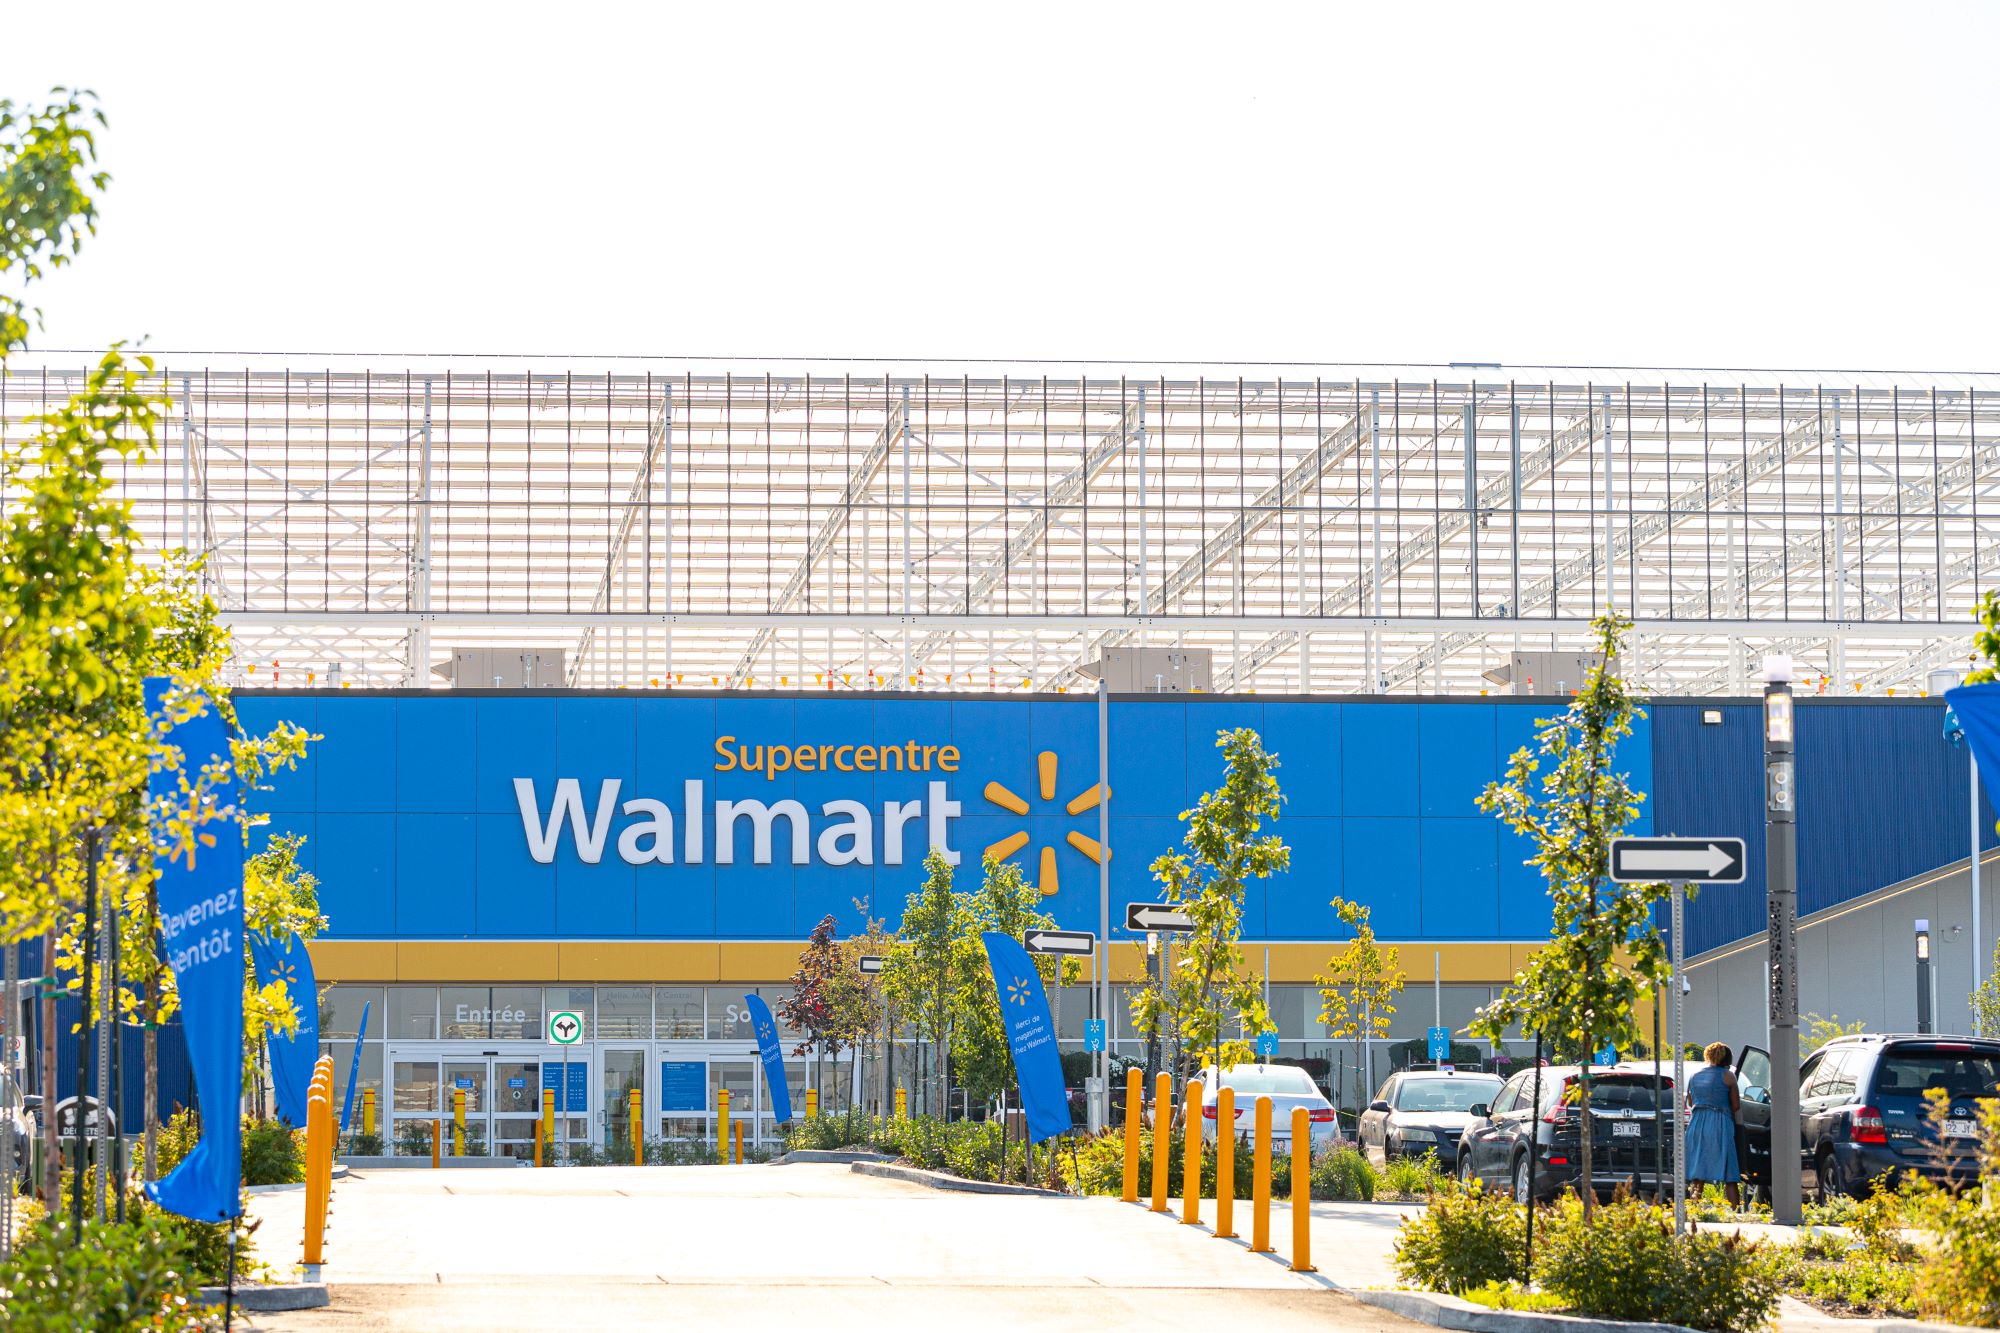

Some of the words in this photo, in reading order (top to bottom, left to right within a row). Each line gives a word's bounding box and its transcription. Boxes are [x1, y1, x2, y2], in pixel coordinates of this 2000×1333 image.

[714, 735, 961, 780] Supercentre
[512, 777, 962, 866] Walmart
[455, 1004, 526, 1023] Entrée
[726, 1004, 789, 1023] Soi
[1027, 1034, 1051, 1049] Walmart
[63, 1126, 98, 1135] DÉETS
